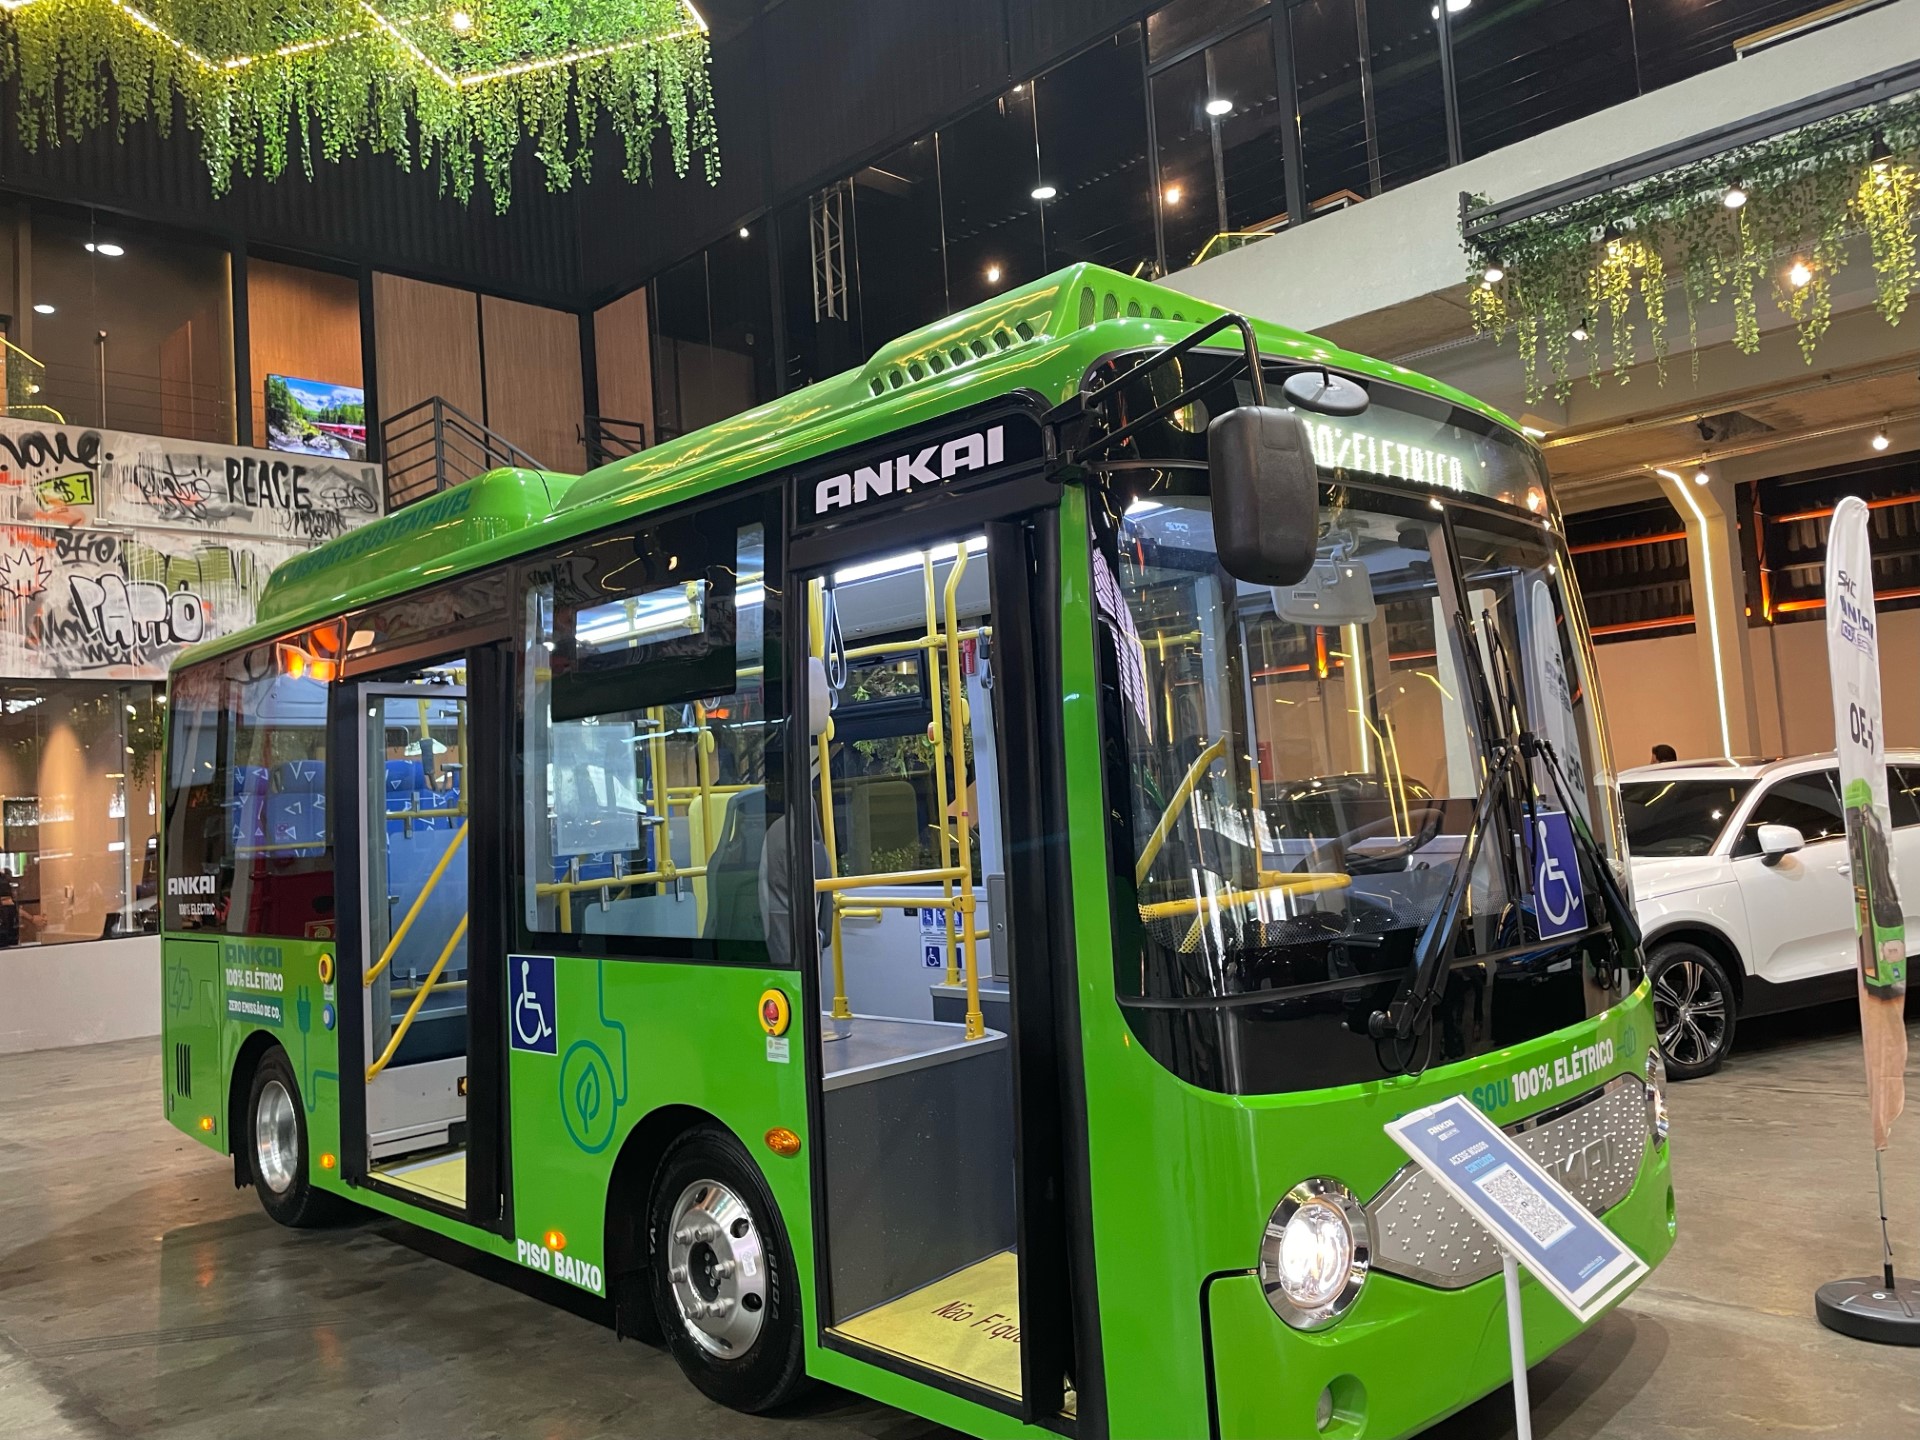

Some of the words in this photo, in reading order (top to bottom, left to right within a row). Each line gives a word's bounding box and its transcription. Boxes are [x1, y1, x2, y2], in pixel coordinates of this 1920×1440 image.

[224, 456, 313, 511] PEACE
[815, 425, 1004, 515] ANKAI
[168, 875, 216, 896] ANKAI
[224, 943, 283, 969] ANKAI
[225, 968, 245, 988] 100%
[245, 966, 284, 993] ELÉTRICO
[228, 999, 241, 1013] ZERO
[241, 1000, 264, 1017] EMISSÃO
[264, 1004, 272, 1018] DE
[1472, 1078, 1510, 1112] SOU
[1511, 1062, 1553, 1103] 100%
[1553, 1037, 1614, 1087] ELÉTRICO
[517, 1238, 550, 1272] PISO
[554, 1250, 602, 1292] BAIXO
[931, 1300, 976, 1322] Não
